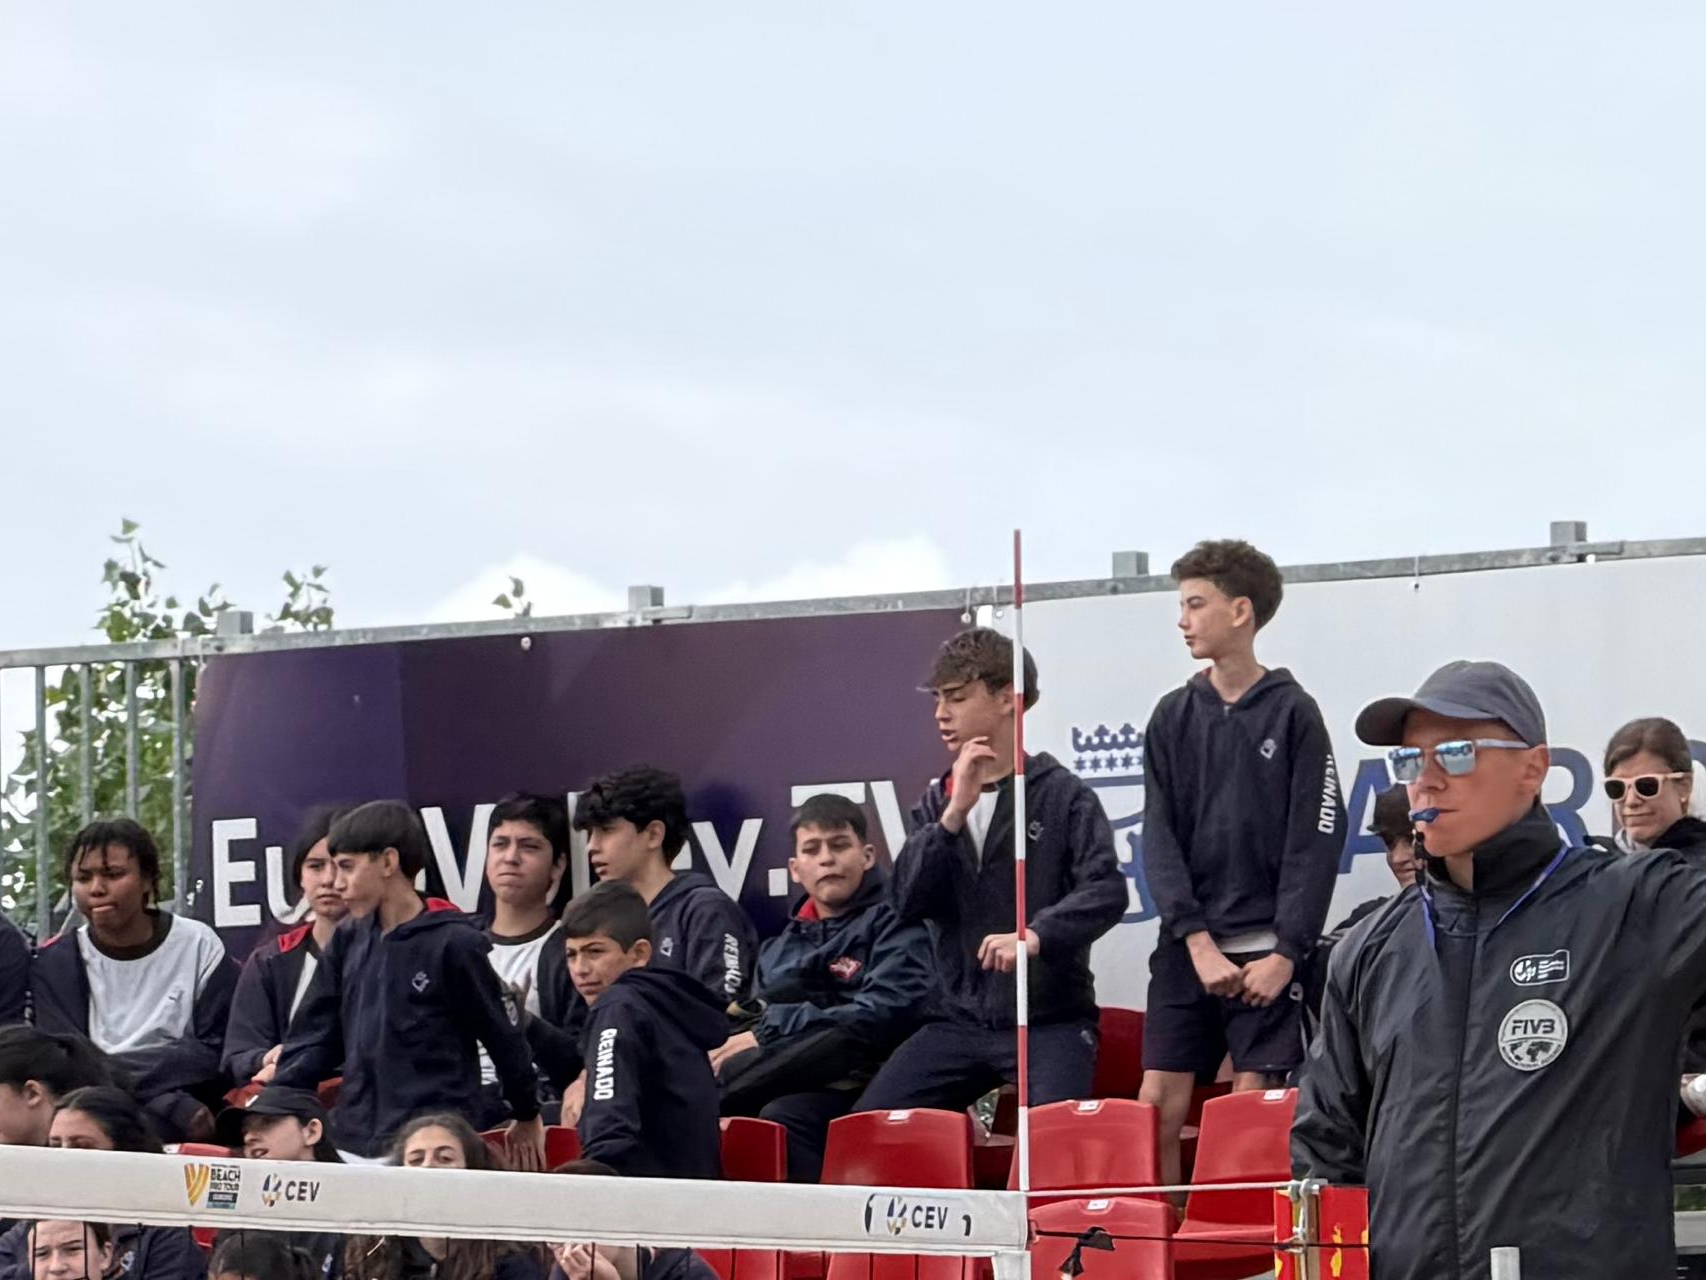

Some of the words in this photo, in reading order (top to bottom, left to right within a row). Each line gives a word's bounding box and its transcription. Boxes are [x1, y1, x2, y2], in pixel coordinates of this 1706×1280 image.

[1512, 1019, 1555, 1035] FIVB
[285, 1181, 320, 1202] CEV
[912, 1205, 948, 1230] CEV
